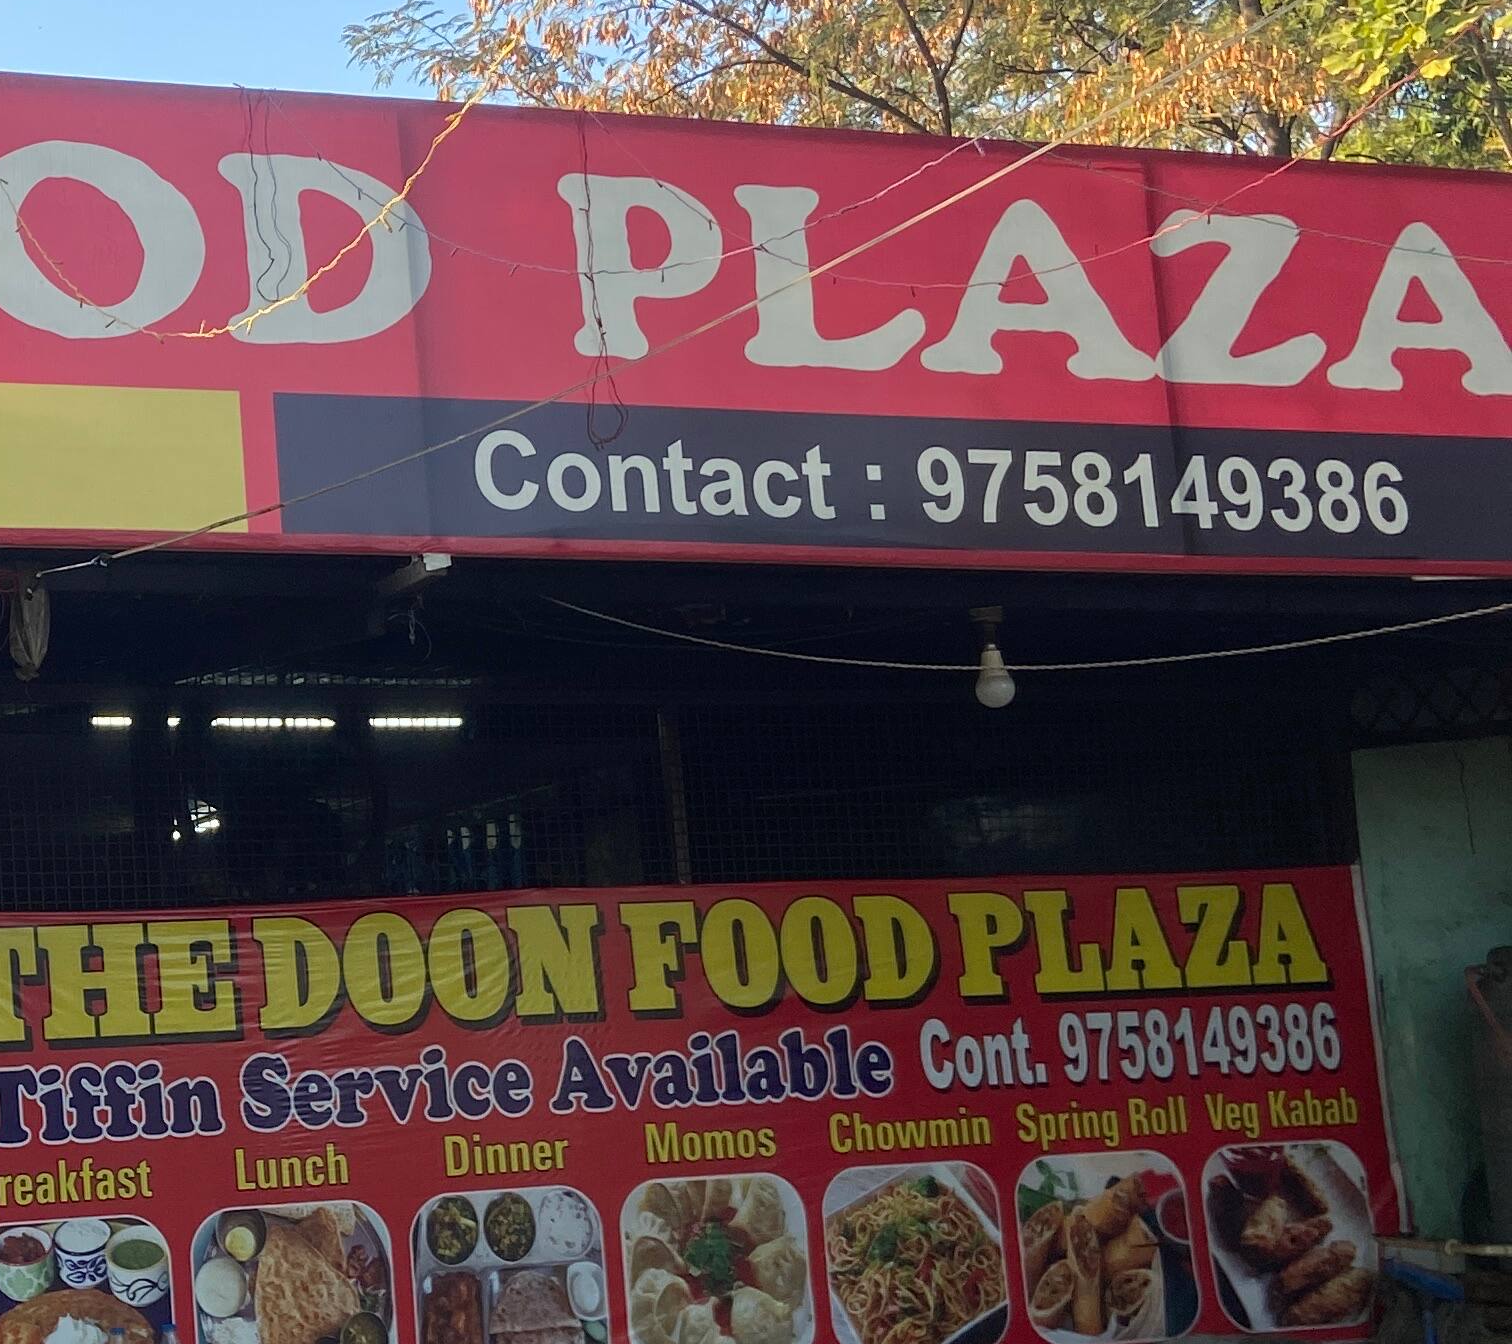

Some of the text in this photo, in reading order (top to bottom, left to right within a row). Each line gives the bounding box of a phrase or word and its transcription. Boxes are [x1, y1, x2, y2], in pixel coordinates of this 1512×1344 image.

[556, 172, 1512, 397] PLAZA
[474, 429, 836, 521] Contact
[918, 446, 1410, 536] 9758149386
[251, 904, 602, 1030] DOON
[618, 896, 937, 1014] FOOD
[947, 883, 1331, 998] PLAZA
[919, 1002, 1342, 1091] Cont. 9758149386
[240, 1045, 533, 1134] Service
[549, 1024, 893, 1115] Available
[828, 1107, 992, 1155] Chowmin
[1016, 1096, 1188, 1151] Spring Roll
[1204, 1088, 1359, 1141] Veg Kabab
[234, 1144, 350, 1192] Lunch
[443, 1133, 569, 1178] Dinner
[645, 1121, 778, 1164] Momos
